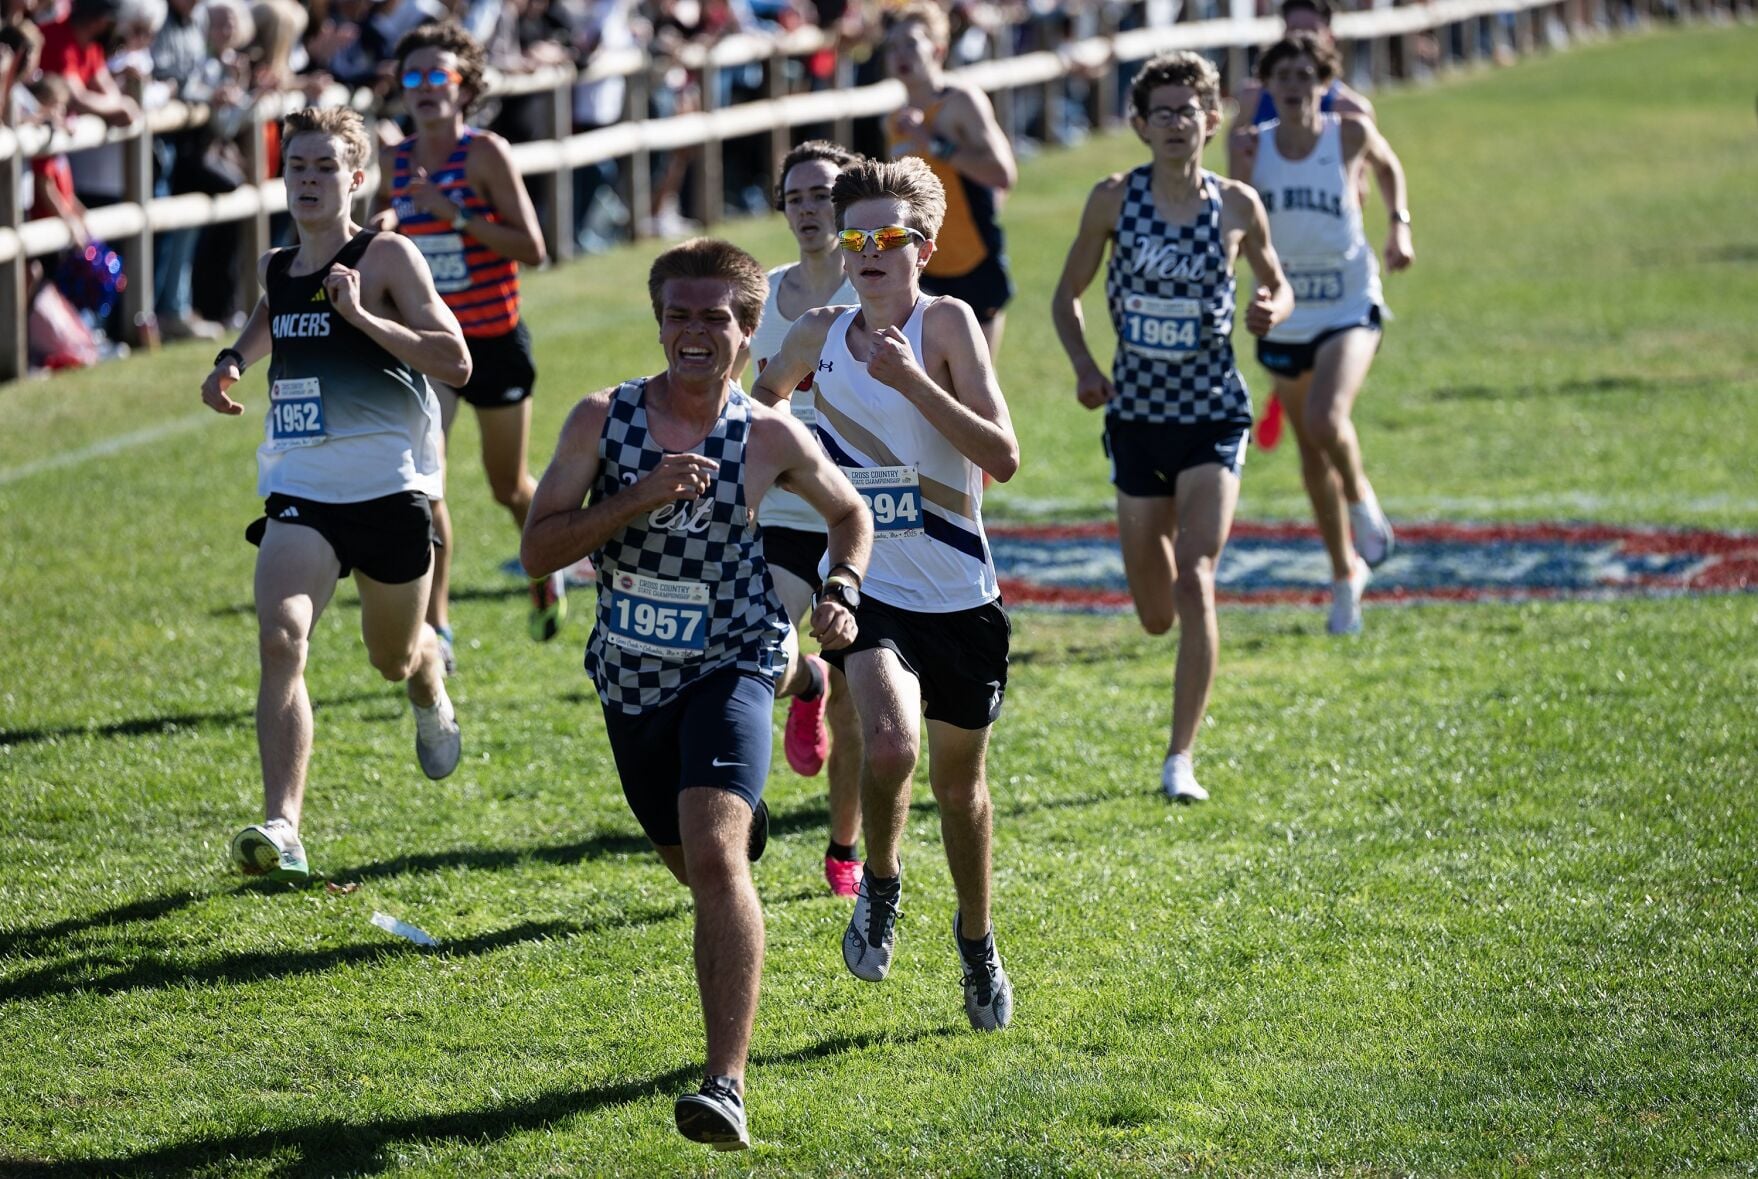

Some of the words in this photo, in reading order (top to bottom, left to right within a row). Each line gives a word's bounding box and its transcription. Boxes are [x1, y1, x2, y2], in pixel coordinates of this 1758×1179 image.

[1283, 185, 1342, 219] BILLS
[1133, 236, 1206, 281] West
[272, 312, 331, 338] ANCERS
[1128, 315, 1196, 347] 1964
[274, 402, 321, 433] 1952
[870, 470, 899, 478] COUNTRY
[639, 579, 658, 591] CROSS
[660, 583, 690, 594] COUNTRY
[616, 599, 703, 642] 1957
